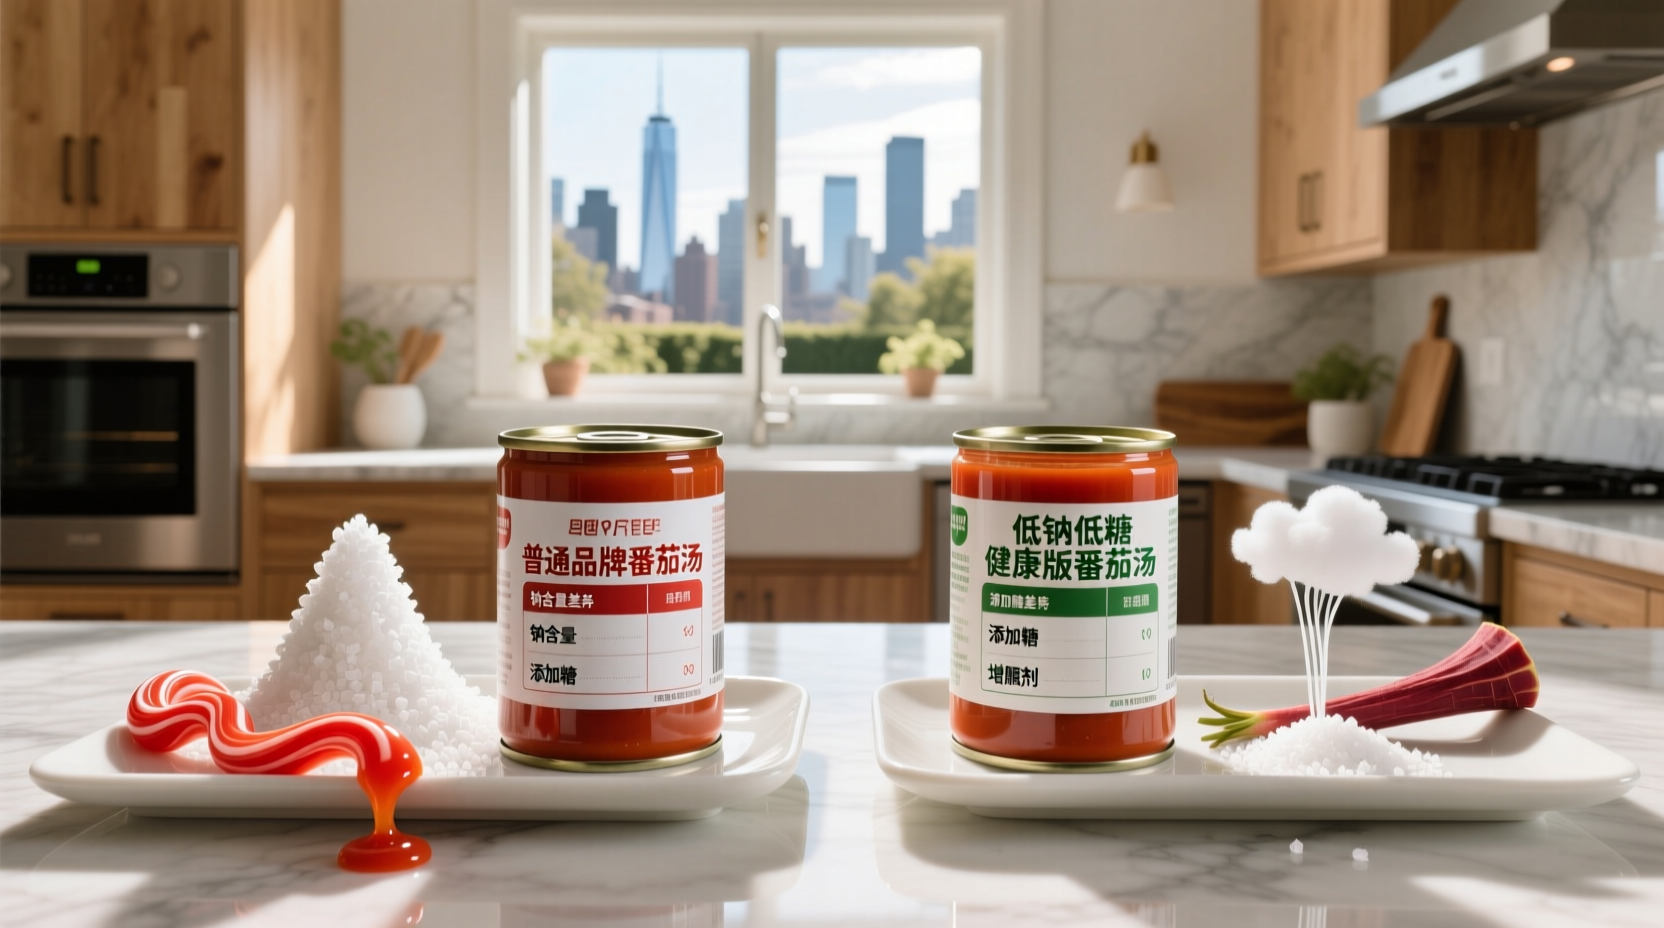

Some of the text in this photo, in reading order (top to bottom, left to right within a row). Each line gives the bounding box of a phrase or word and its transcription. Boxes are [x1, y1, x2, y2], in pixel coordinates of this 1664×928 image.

[1012, 513, 1133, 546] 低钠低糖
[522, 543, 703, 577] 普通品牌番茄汤
[985, 544, 1157, 580] 健康版番茄汤
[530, 624, 577, 645] 钠含量
[988, 624, 1039, 648] 添加糖
[530, 663, 577, 686] 添加糖
